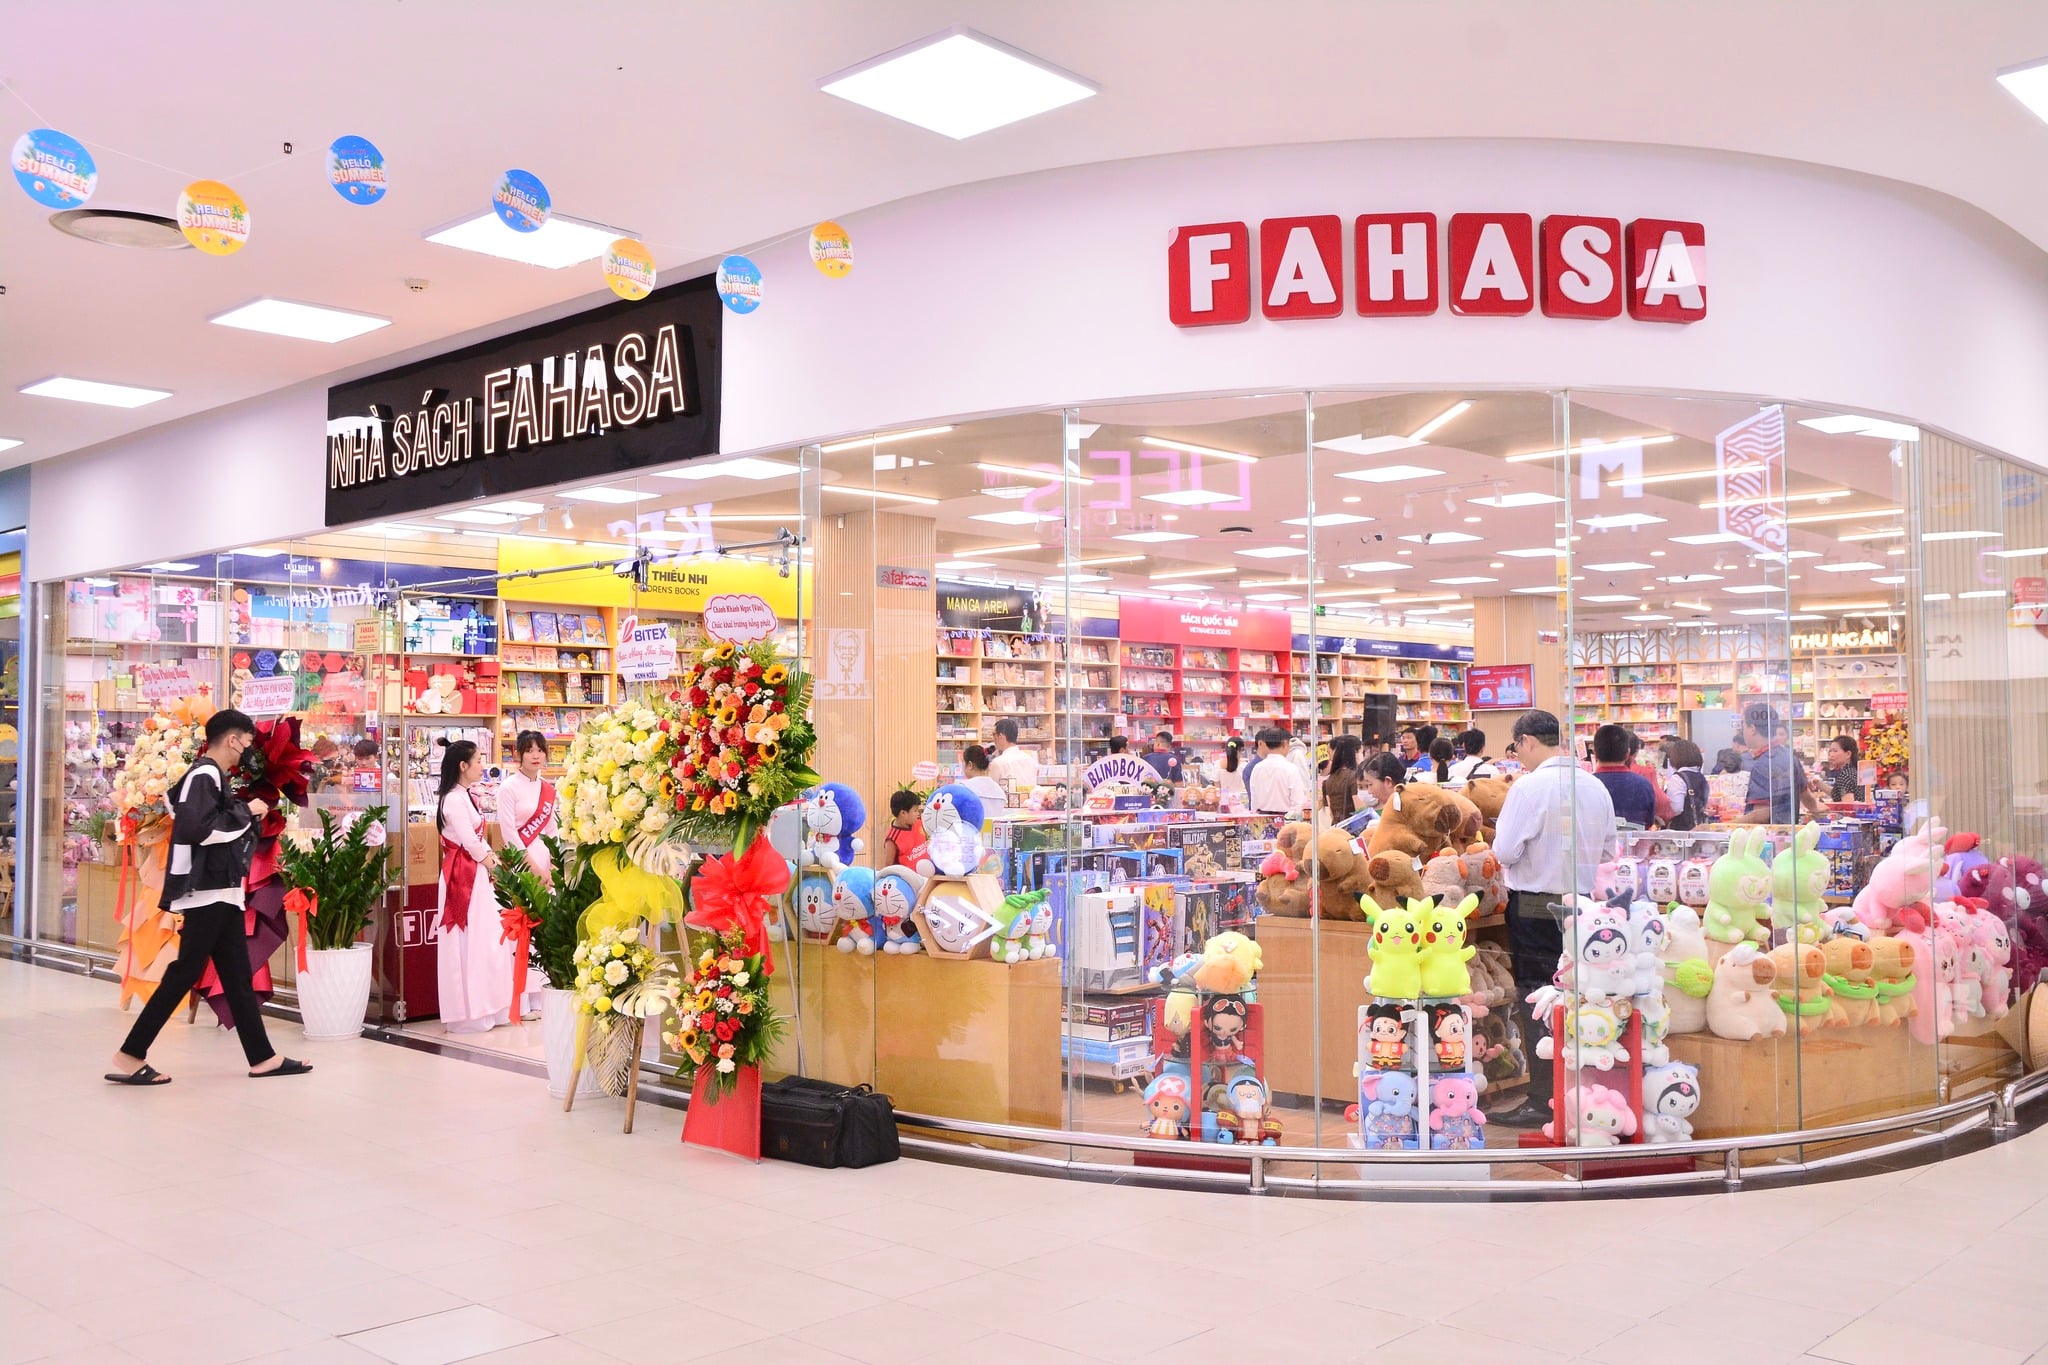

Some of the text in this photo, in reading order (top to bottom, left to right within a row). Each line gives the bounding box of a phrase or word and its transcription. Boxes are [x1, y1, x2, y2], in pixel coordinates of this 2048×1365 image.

[36, 150, 76, 174] HELLO
[342, 157, 372, 169] HELLO
[17, 158, 90, 195] SUMMER
[332, 168, 387, 184] SUMMER
[510, 185, 537, 206] HELLO
[196, 203, 230, 217] HELLO
[496, 191, 546, 224] SUMMER
[183, 214, 247, 235] SUMMER
[822, 240, 841, 250] HELLO
[617, 255, 643, 271] HELLO
[814, 249, 854, 261] SUMMER
[605, 263, 655, 287] SUMMER
[1188, 222, 1705, 312] FAHASA
[728, 273, 751, 285] HELLO
[720, 283, 762, 298] SUMMER
[330, 323, 685, 489] NHÀ SÁCH FAHASA
[652, 567, 708, 585] THIẾU NHI
[891, 569, 927, 588] fahasa
[675, 587, 700, 596] BOOKS
[946, 597, 1009, 615] MANGA AREA
[1181, 612, 1201, 624] SÁCH
[1202, 614, 1222, 626] QUỐC
[634, 627, 667, 642] BITEX
[1790, 629, 1889, 649] THU NGÂN
[1088, 758, 1144, 788] BLINDBOX
[521, 801, 553, 838] FAHASA
